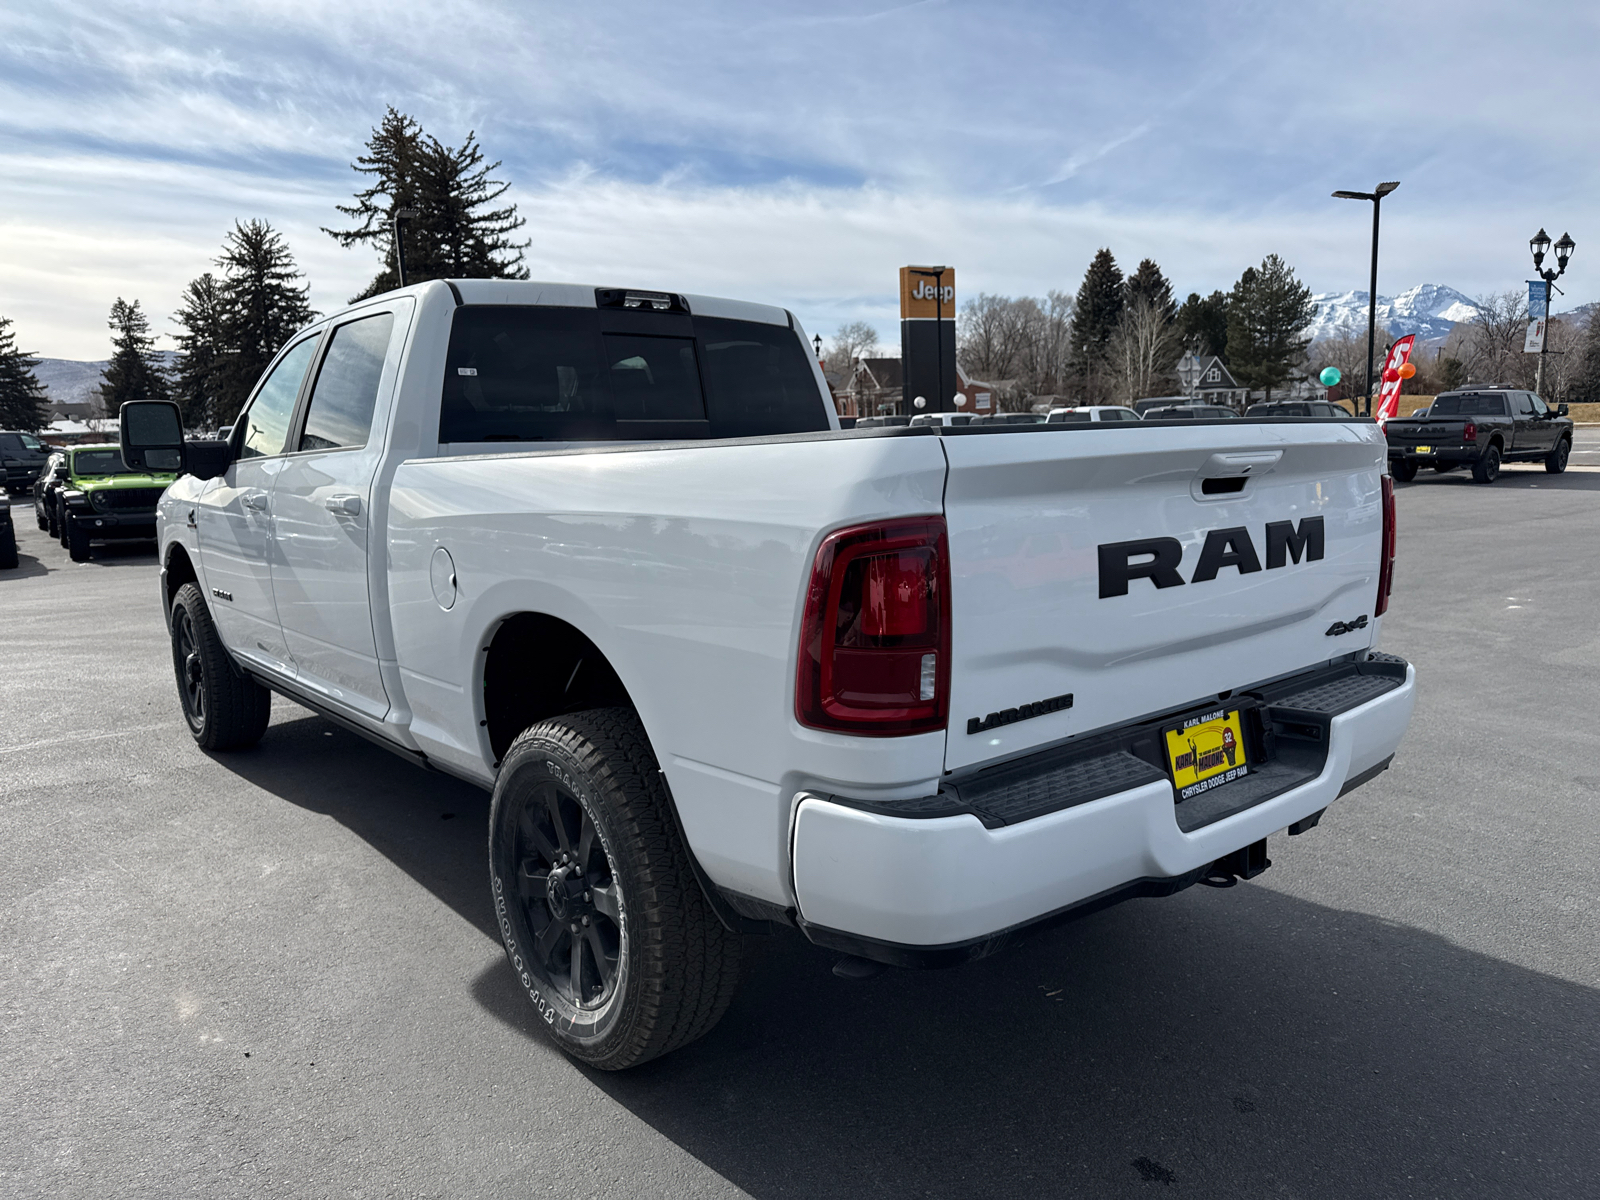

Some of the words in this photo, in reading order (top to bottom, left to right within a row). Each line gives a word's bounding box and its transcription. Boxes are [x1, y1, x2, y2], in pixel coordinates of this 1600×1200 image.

[912, 280, 954, 304] Jeep
[1098, 515, 1325, 599] RAM
[966, 692, 1074, 735] LARAMIE
[1183, 718, 1200, 729] KARL
[1201, 710, 1224, 723] MALONE
[1224, 732, 1232, 743] 32
[1175, 751, 1193, 772] KARL
[1198, 750, 1225, 773] MALONE
[1182, 781, 1208, 799] CHRYSLER
[1208, 774, 1225, 789] DODGE
[1225, 770, 1236, 782] JEEP
[1236, 765, 1248, 777] RAM
